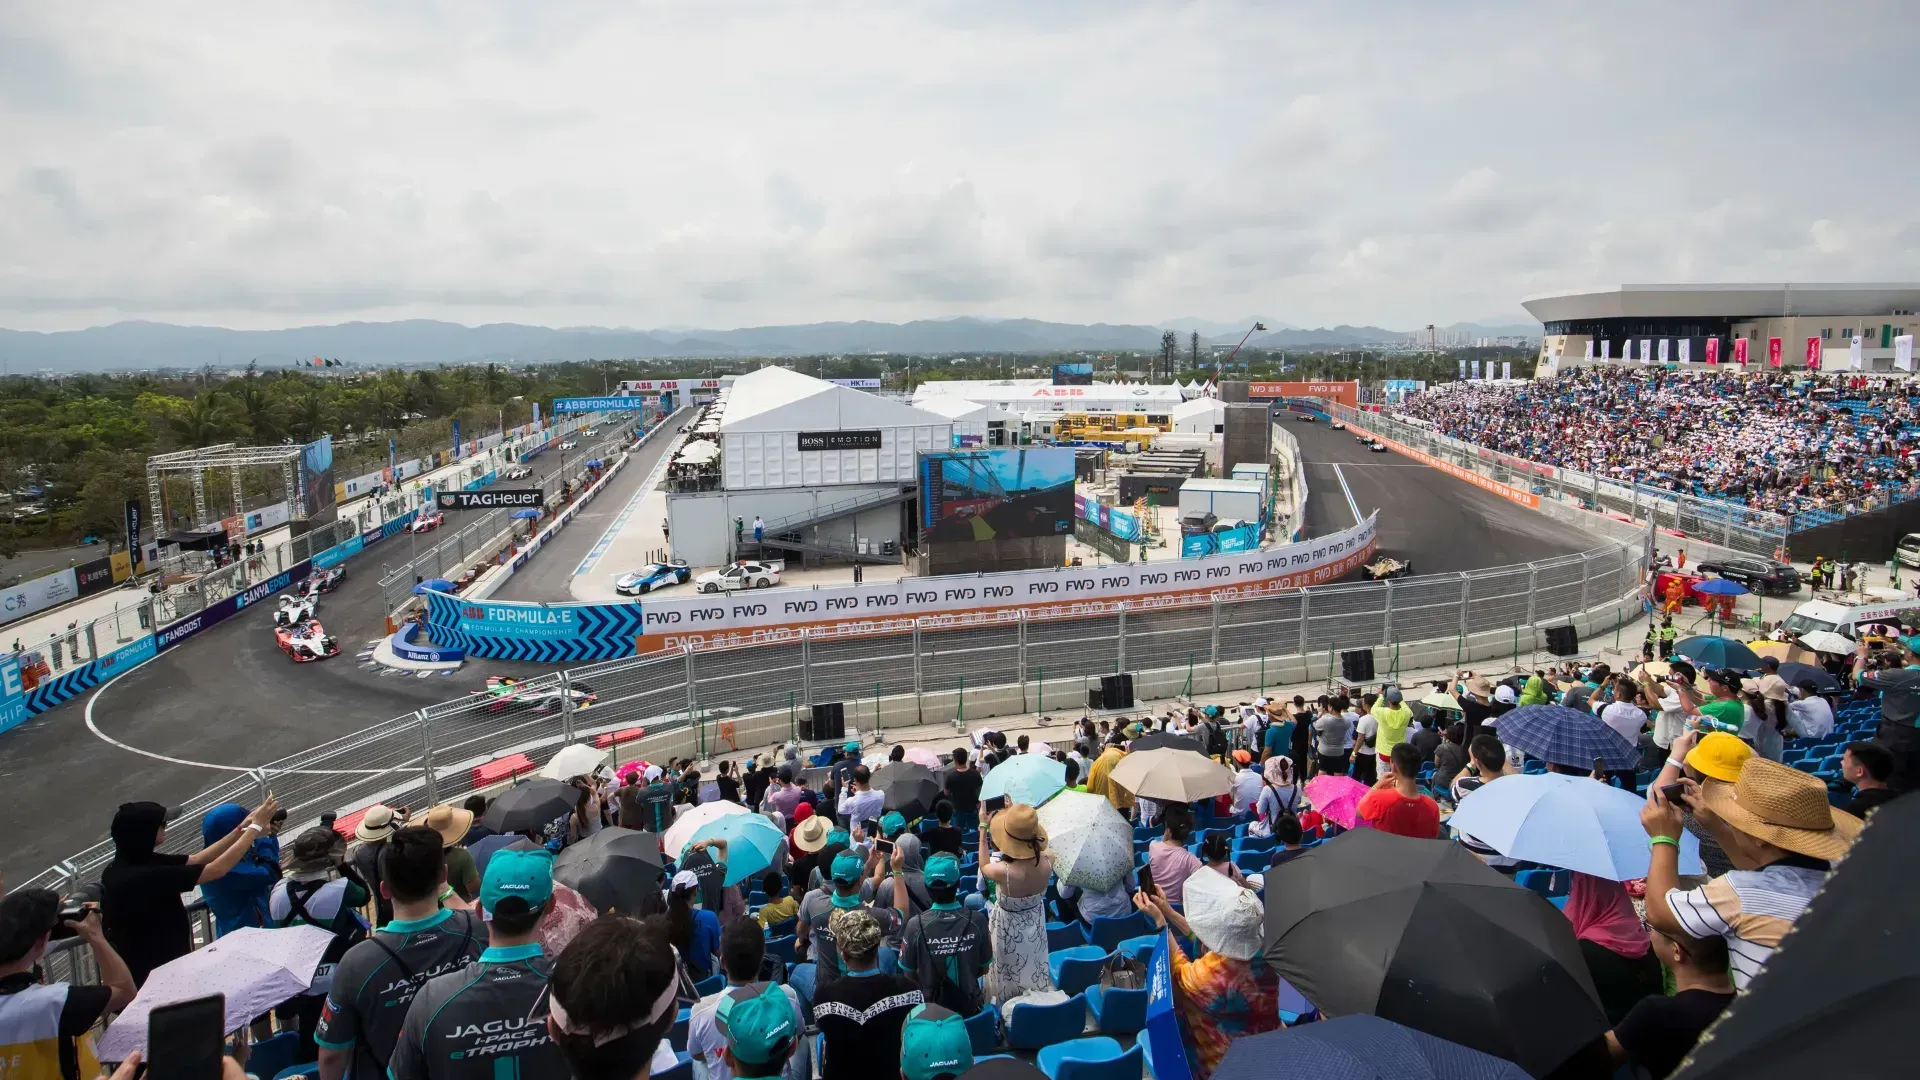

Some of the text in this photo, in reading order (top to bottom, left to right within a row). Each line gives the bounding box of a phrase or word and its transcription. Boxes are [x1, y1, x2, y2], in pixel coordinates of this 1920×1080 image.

[634, 382, 653, 390] ABB
[659, 381, 678, 390] ABB
[700, 380, 718, 388] ABB
[1314, 567, 1331, 582] FWD
[646, 611, 682, 625] FWD
[690, 608, 724, 622] FWD
[733, 604, 767, 618] FWD
[784, 600, 818, 614] FWD
[826, 597, 858, 610] FWD
[866, 594, 898, 607] FWD
[906, 591, 938, 604] FWD
[946, 588, 976, 601] FWD
[984, 585, 1014, 598] FWD
[1029, 582, 1058, 595] FWD
[1066, 579, 1095, 592] FWD
[1102, 576, 1130, 589] FWD
[1140, 573, 1168, 585] FWD
[1174, 570, 1200, 582] FWD
[1206, 566, 1231, 579] FWD
[1239, 561, 1263, 574] FWD
[1267, 557, 1287, 570] FWD
[1292, 552, 1310, 566] FWD
[1312, 547, 1326, 561] FWD
[1329, 543, 1344, 555] FWD
[462, 607, 485, 620] ABB
[515, 628, 572, 636] CHAMPIONSHIP
[407, 651, 429, 661] Allianz
[414, 935, 438, 946] JAGUAR
[927, 934, 975, 945] JAGUAR
[765, 1020, 790, 1040] JAGUAR
[475, 1028, 538, 1045] I-PACE
[930, 1059, 959, 1068] JAGUAR
